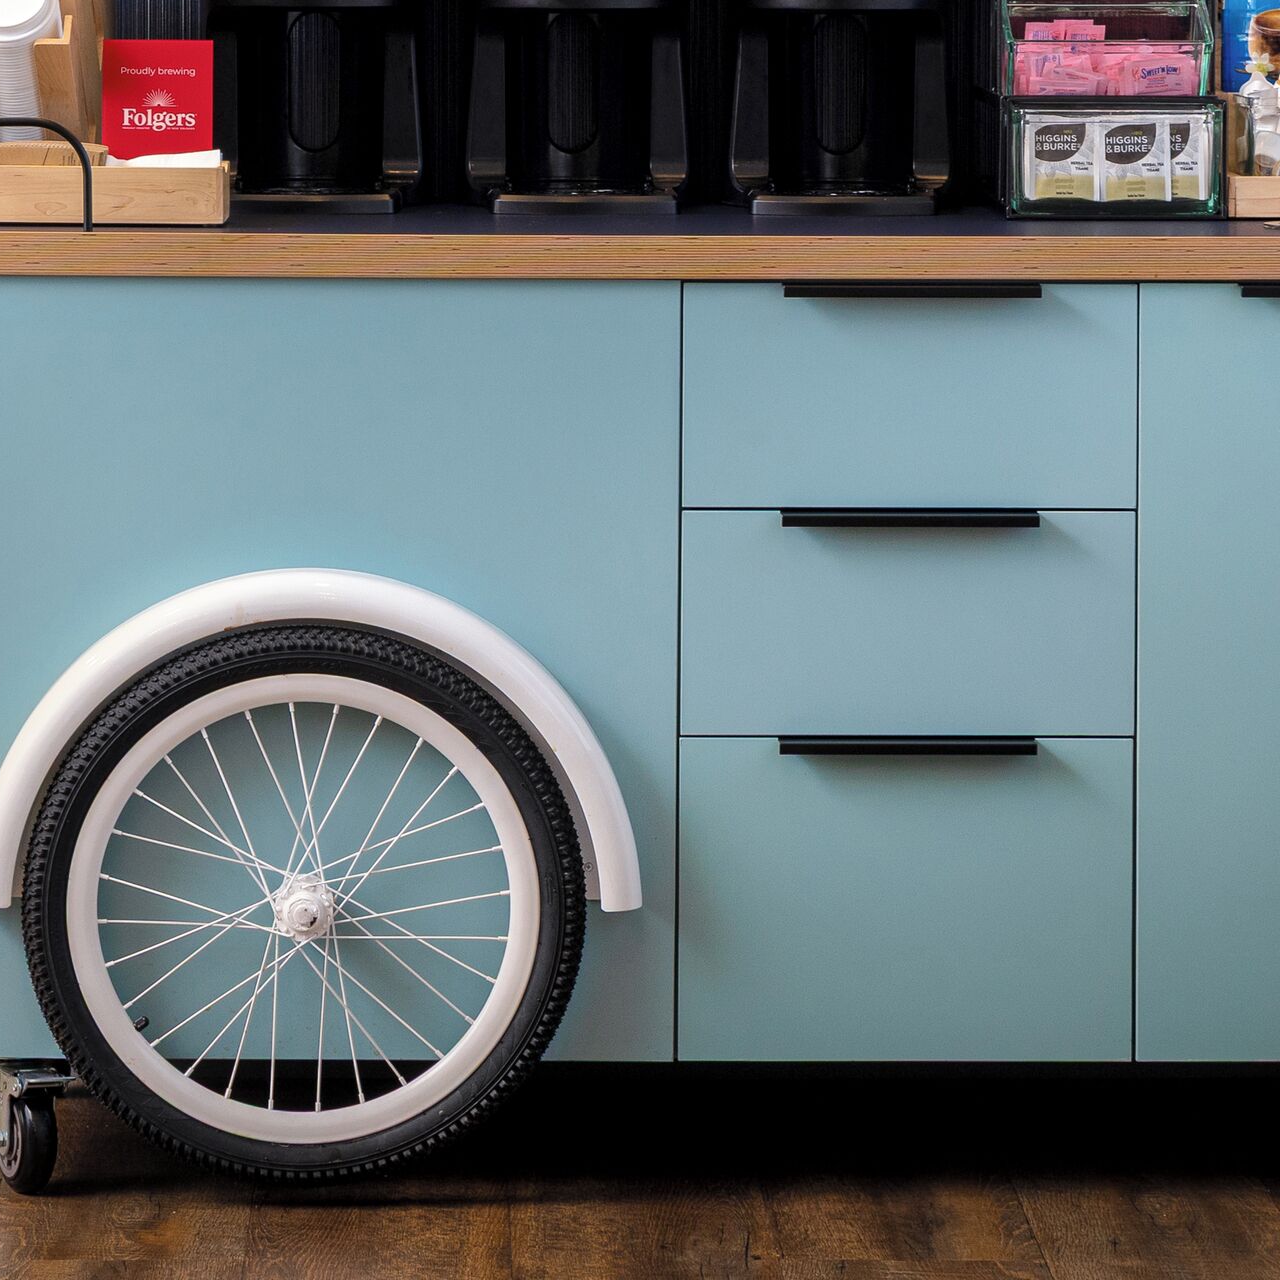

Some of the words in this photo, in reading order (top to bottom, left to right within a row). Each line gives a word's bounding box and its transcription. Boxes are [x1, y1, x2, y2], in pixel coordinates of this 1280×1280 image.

[120, 66, 156, 77] Proudly
[157, 67, 196, 77] brewing
[122, 108, 196, 131] Folgers
[1035, 134, 1078, 142] HIGGINS
[1105, 135, 1148, 144] HIGGINS
[1043, 142, 1077, 151] BURKE
[1113, 144, 1148, 153] BURKE
